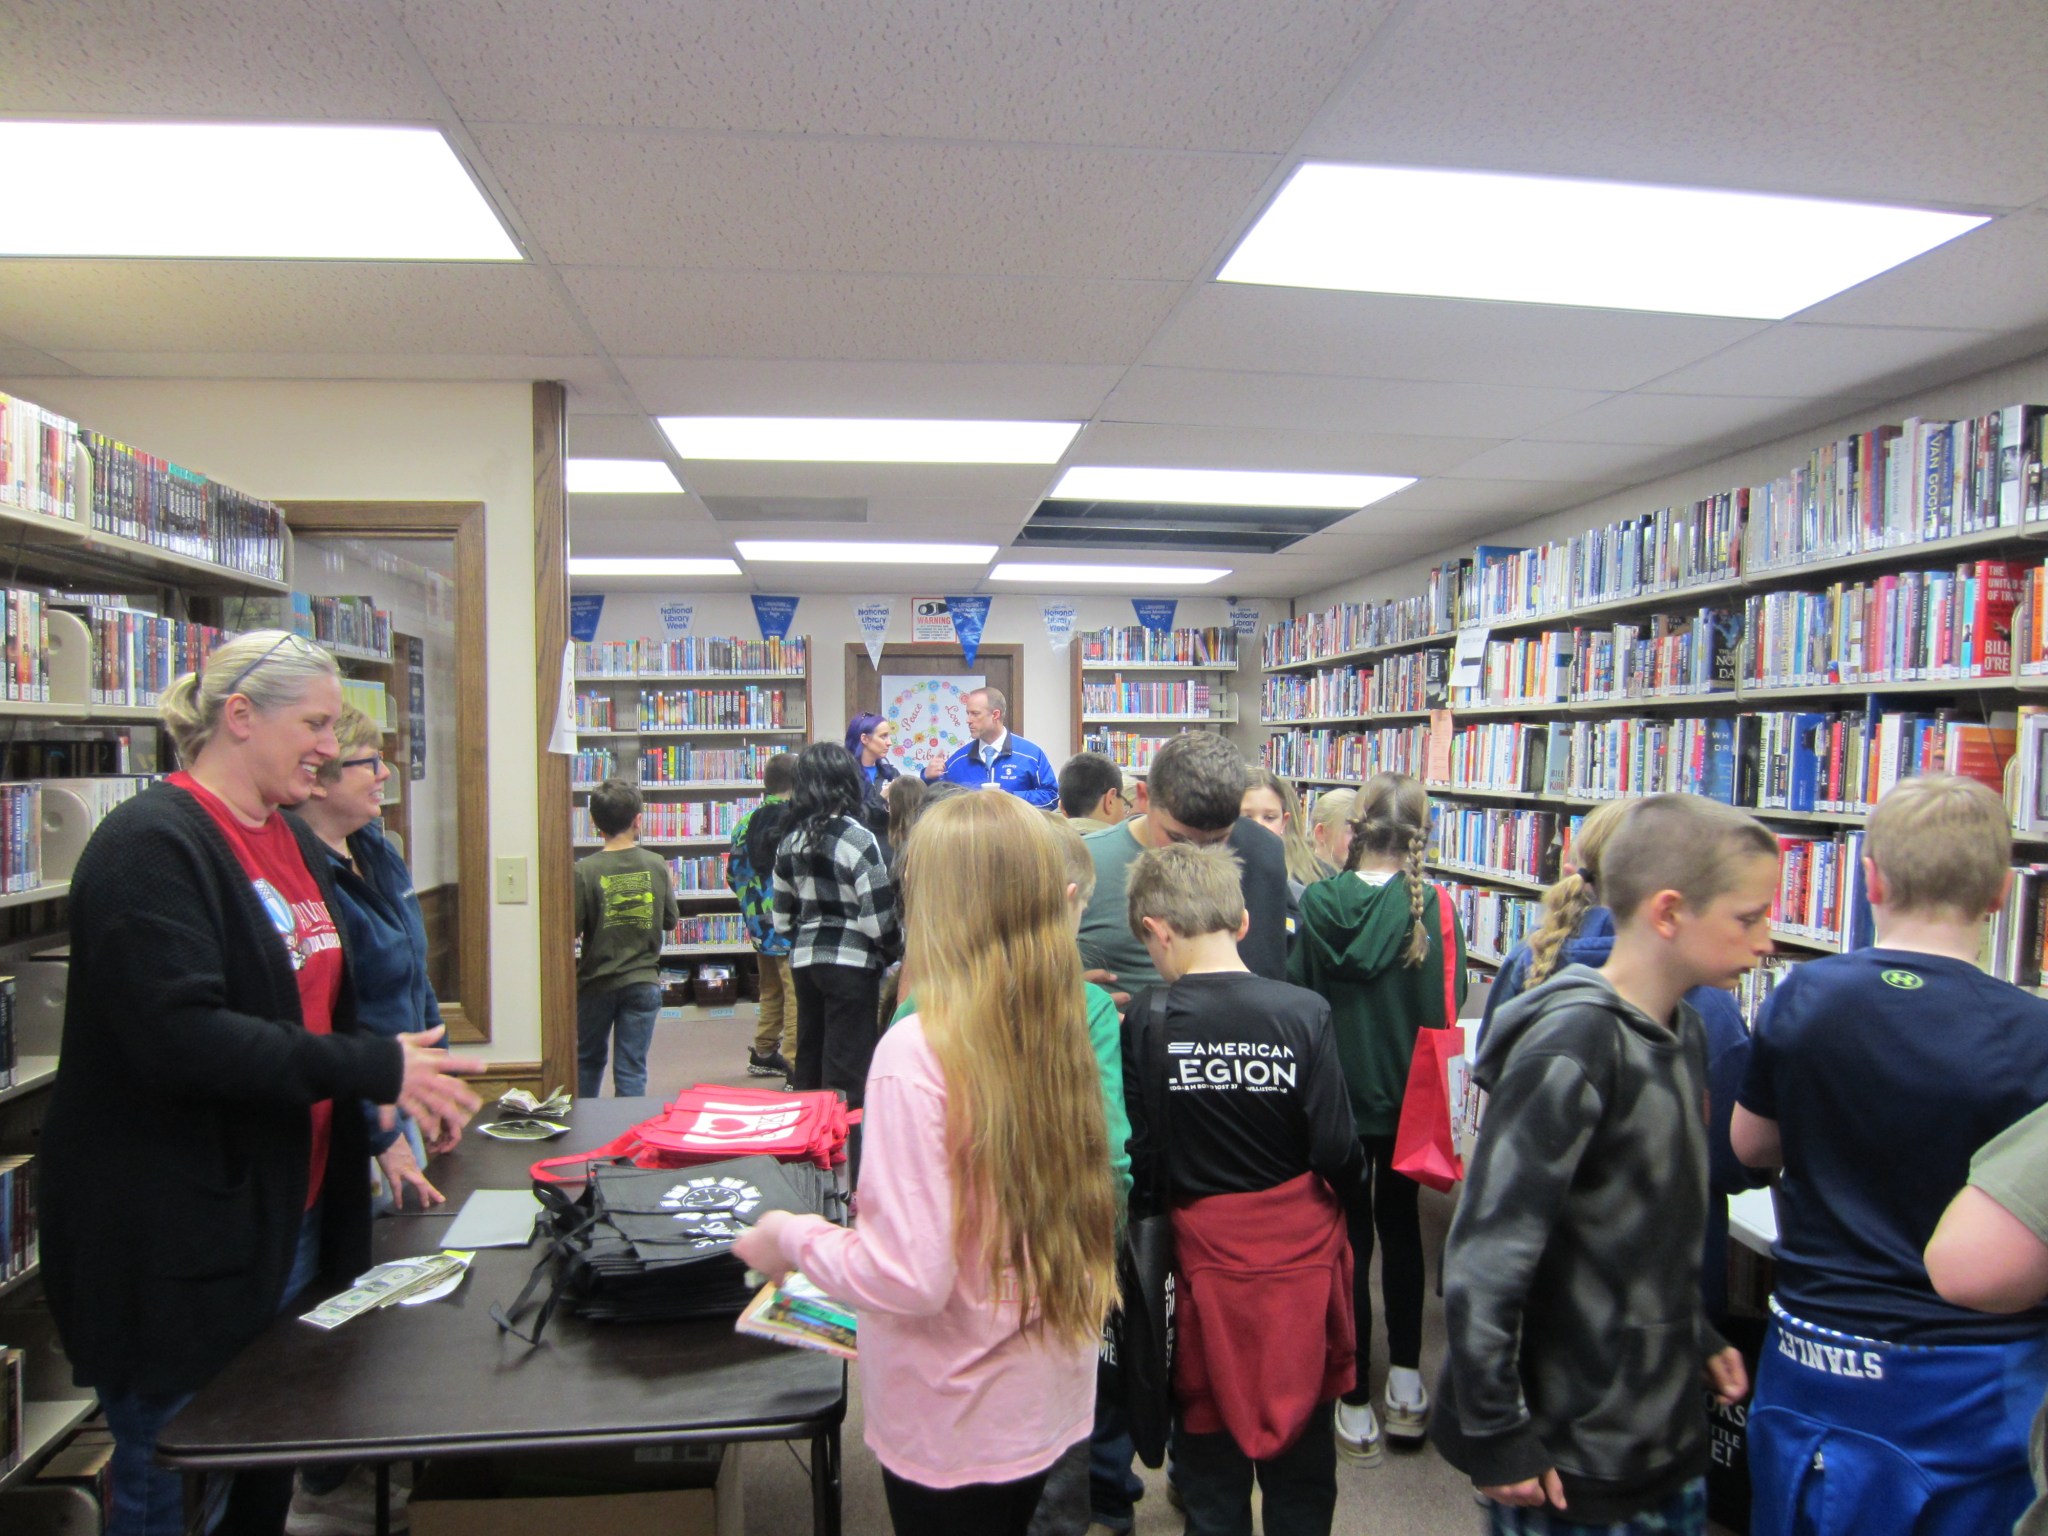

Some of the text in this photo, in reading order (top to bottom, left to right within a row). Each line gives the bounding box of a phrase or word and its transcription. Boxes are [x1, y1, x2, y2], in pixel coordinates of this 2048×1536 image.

[1926, 436, 1940, 520] VAN GOGH
[1988, 566, 2004, 577] THE
[1987, 590, 1999, 601] OF
[660, 607, 693, 615] National
[858, 608, 890, 616] National
[1044, 608, 1075, 617] National
[1229, 611, 1259, 619] National
[664, 615, 689, 623] Library
[861, 616, 887, 625] Library
[916, 616, 951, 624] WARNING
[1047, 617, 1072, 626] Library
[1233, 619, 1256, 627] Library
[667, 622, 687, 630] Week
[1049, 624, 1070, 632] Week
[1984, 640, 2010, 655] BILL
[1715, 655, 1735, 666] NO
[1984, 657, 2010, 671] O'RE
[1719, 668, 1735, 679] DA
[901, 703, 923, 732] Peace
[944, 705, 961, 727] Love
[1635, 744, 1644, 785] BIRDS
[1758, 756, 1766, 787] JACKSON
[1194, 1042, 1294, 1058] AMERICAN
[1169, 1058, 1296, 1088] EGION
[1778, 1326, 1884, 1380] STANLEY
[1705, 1391, 1746, 1428] OKS
[1712, 1424, 1741, 1449] TTLE
[1711, 1438, 1732, 1468] E!
